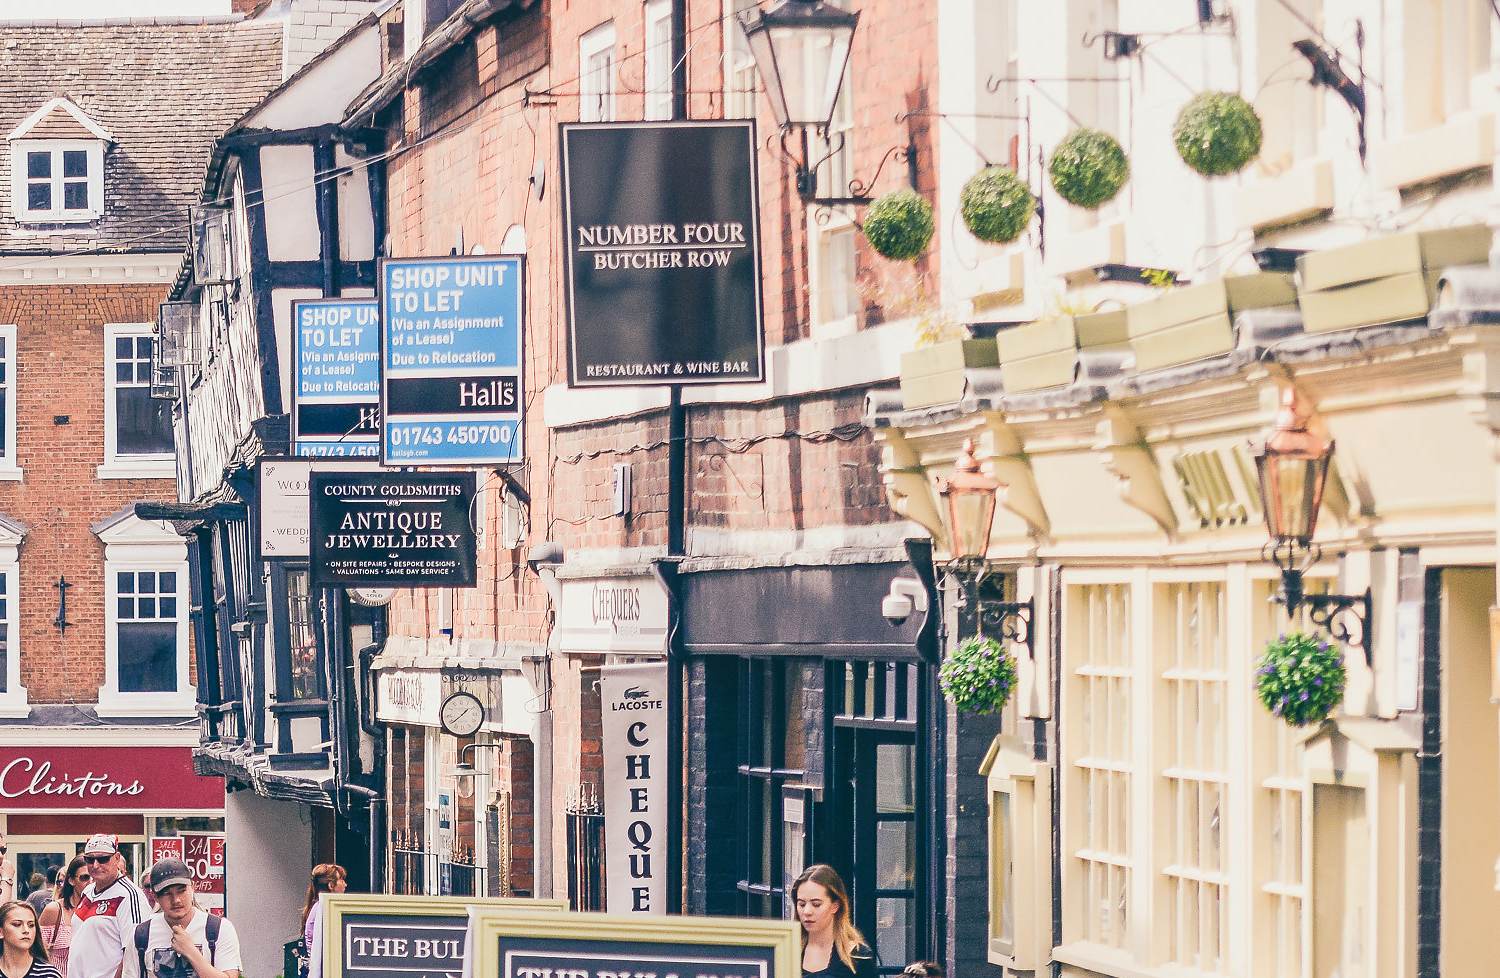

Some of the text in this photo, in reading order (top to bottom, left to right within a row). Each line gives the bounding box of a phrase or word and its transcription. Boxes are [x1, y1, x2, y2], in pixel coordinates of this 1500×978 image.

[578, 221, 746, 246] NUMBER FOUR
[594, 250, 732, 270] BUTCHER ROW
[391, 264, 508, 290] SHOP UNIT
[391, 289, 464, 313] TO LET
[302, 308, 351, 327] SHOP
[416, 319, 430, 331] an
[433, 315, 504, 332] Assignment
[302, 327, 363, 347] TO LET
[392, 331, 454, 346] of a Lease)
[322, 352, 335, 362] an
[337, 350, 380, 363] Assignm
[392, 350, 496, 366] Due to Relocation
[586, 361, 749, 377] RESTAURANT & WINE BAR
[302, 379, 380, 393] Due to Relocati
[459, 380, 515, 407] Halls
[391, 424, 511, 446] 01743 450700
[324, 485, 462, 496] COUNTY GOLDSMITHS
[340, 512, 443, 534] ANTIQUE
[324, 534, 461, 549] JEWELLERY
[592, 582, 640, 636] CHEQUERS
[612, 701, 663, 711] LACOSTE
[160, 840, 177, 849] SALE
[353, 937, 464, 960] THE BUL
